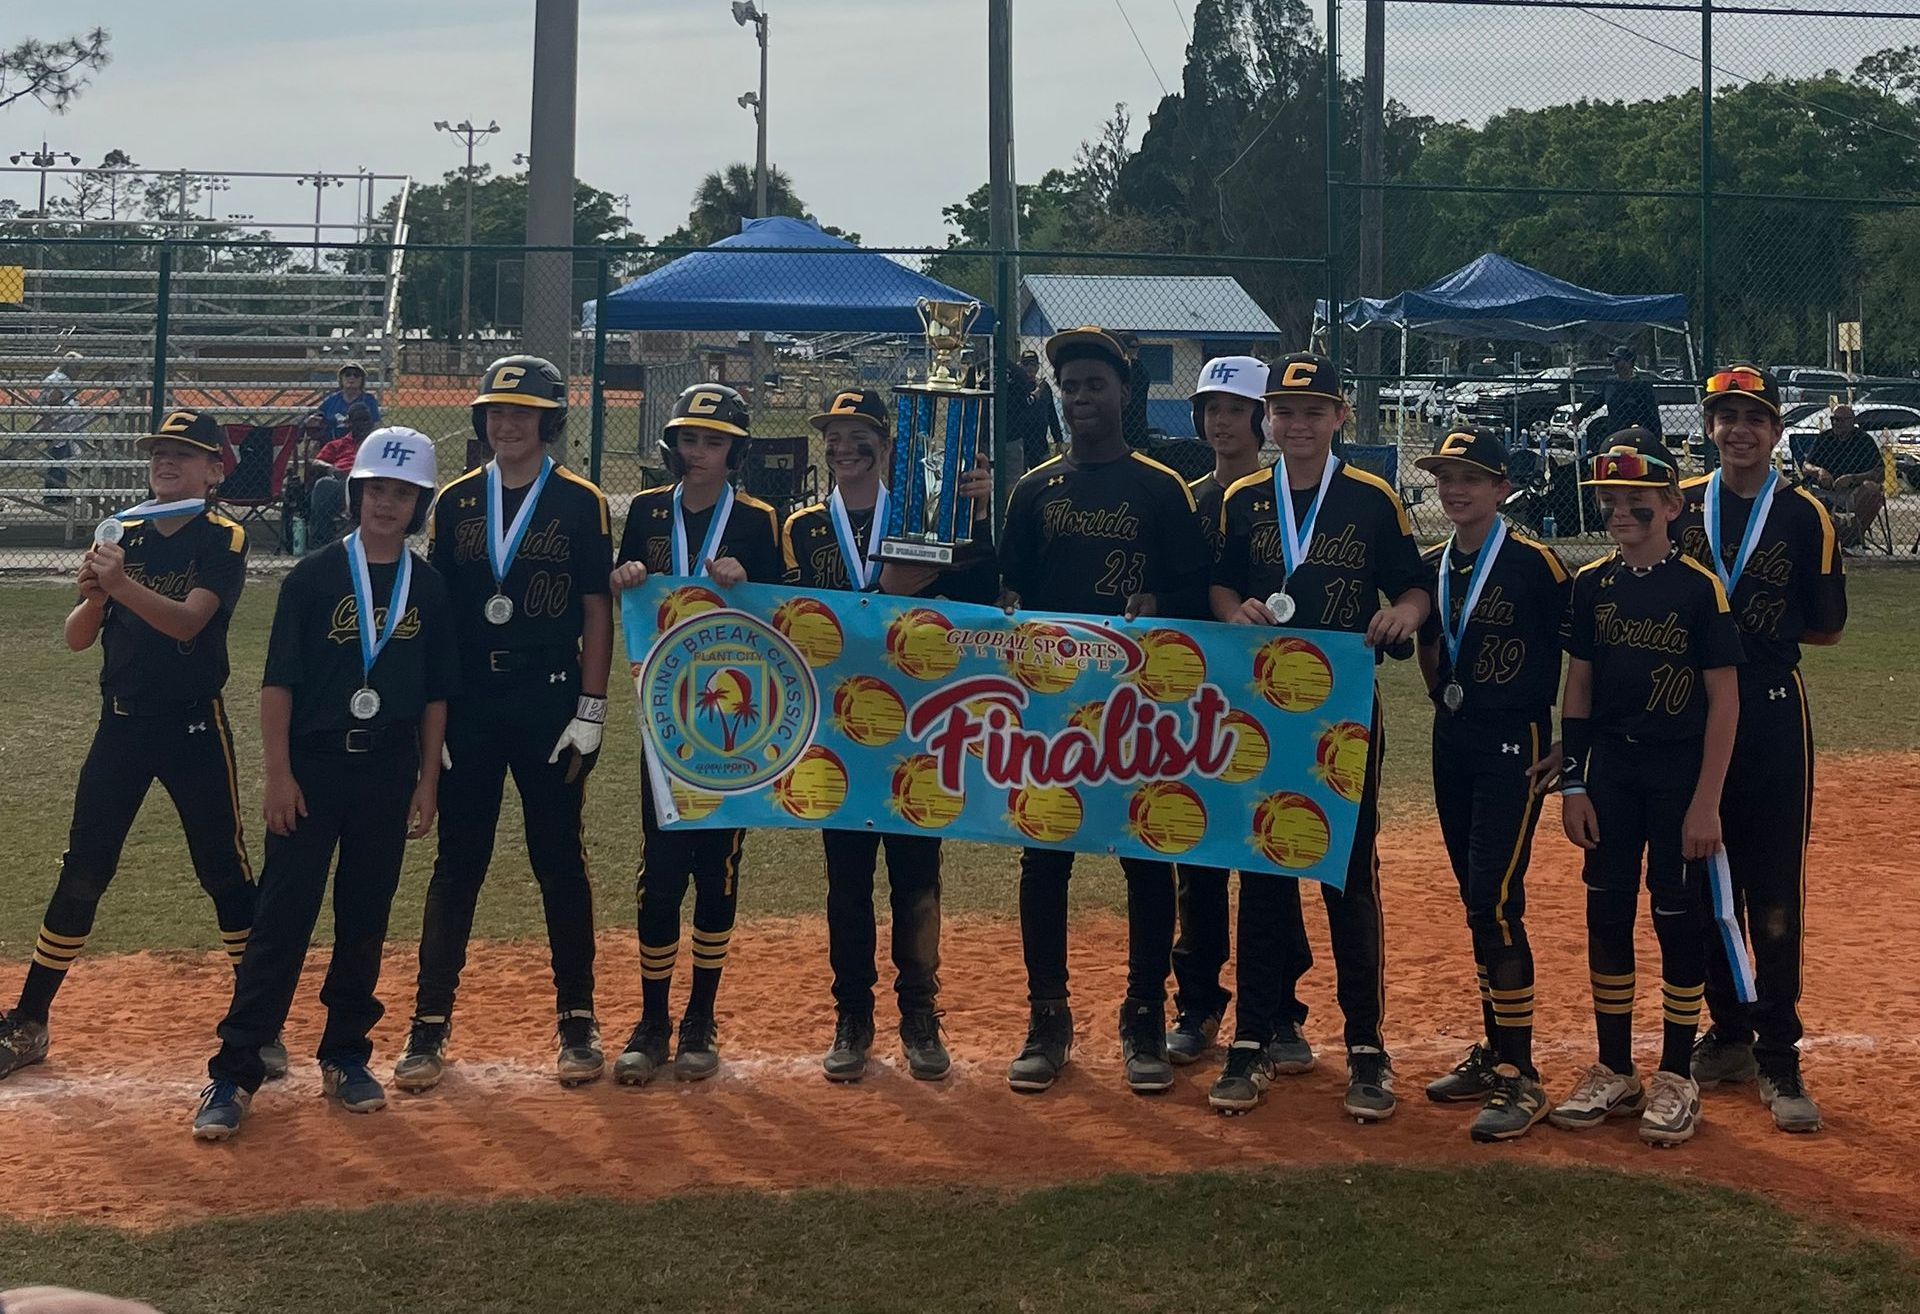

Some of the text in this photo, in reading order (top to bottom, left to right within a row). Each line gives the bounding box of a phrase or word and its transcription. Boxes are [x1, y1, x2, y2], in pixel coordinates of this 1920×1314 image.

[491, 366, 527, 389] C
[1280, 362, 1318, 387] C
[159, 411, 199, 432] C
[687, 392, 723, 414] C
[829, 392, 864, 414] C
[1440, 432, 1477, 455] C
[454, 516, 570, 564] Flida
[1043, 498, 1140, 542] Florida
[1251, 520, 1366, 570] Floida
[523, 570, 571, 618] 00
[1094, 549, 1147, 602] 23
[329, 594, 421, 644] Cns
[1593, 603, 1689, 655] Florida
[694, 651, 764, 662] PLANT CITY
[946, 629, 1119, 659] GLOBAL SPORTS
[954, 644, 1111, 672] ALLIANCE
[1474, 634, 1526, 684] 39
[655, 626, 801, 740] SPRING BREAK CLASSIC
[1646, 663, 1695, 716] 10
[908, 675, 1237, 795] Finalist
